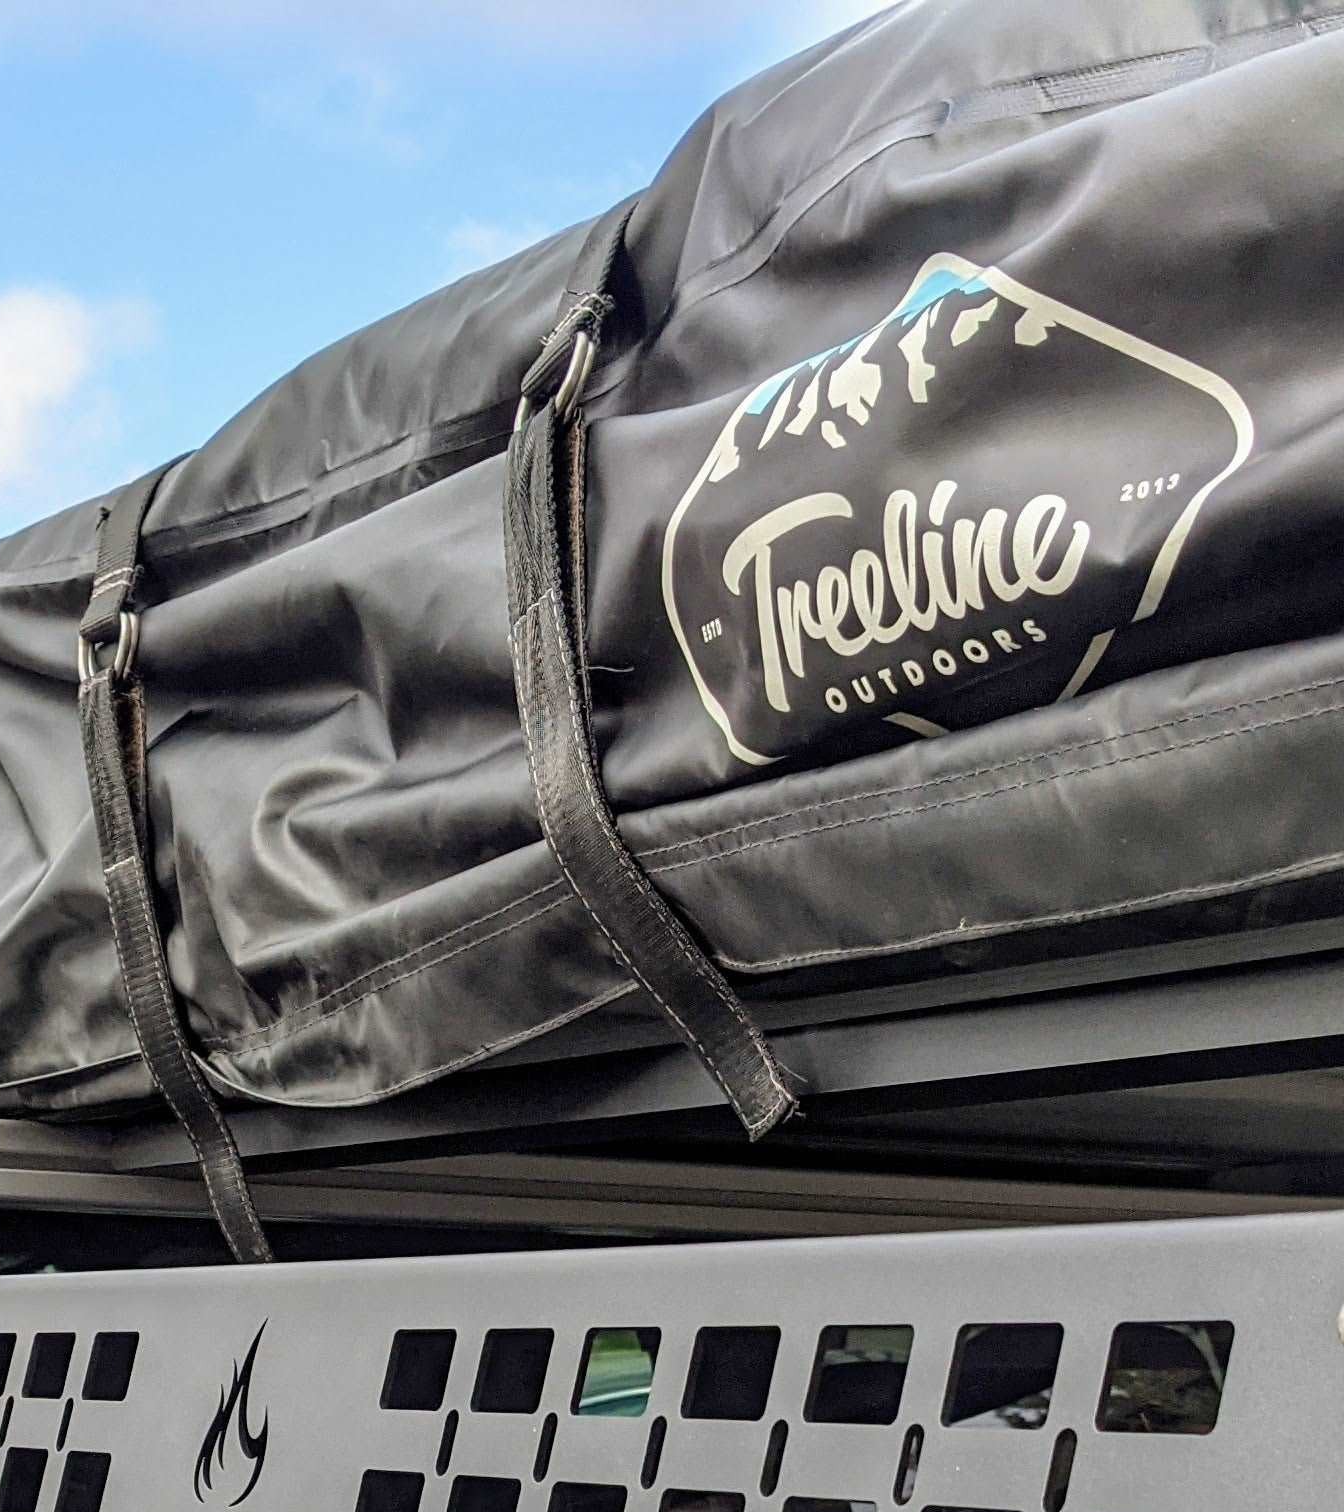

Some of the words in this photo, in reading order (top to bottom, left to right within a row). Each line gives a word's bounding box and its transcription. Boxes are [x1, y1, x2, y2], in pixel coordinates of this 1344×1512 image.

[1119, 472, 1181, 502] 2013
[722, 479, 1091, 712] Treeline
[823, 617, 1048, 714] OUTDOORS
